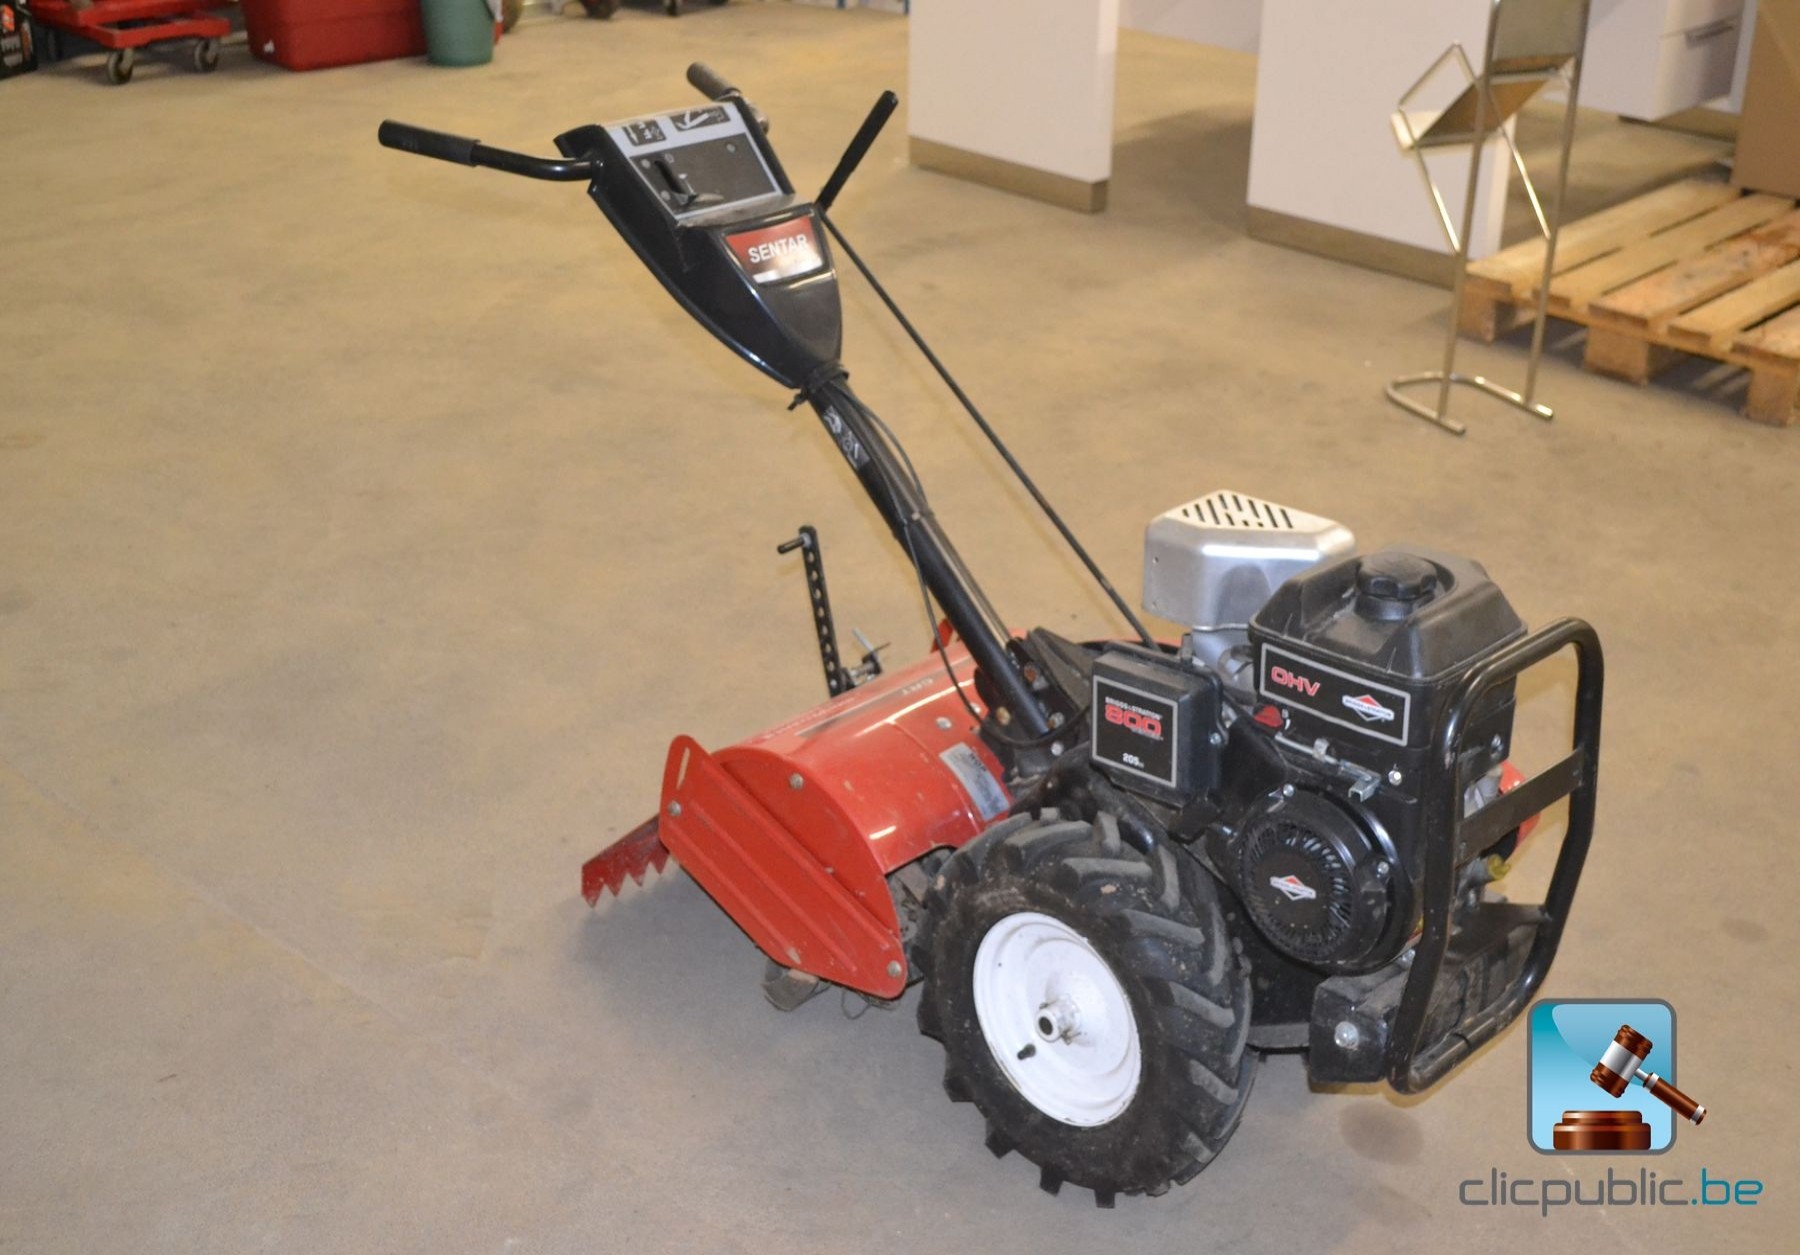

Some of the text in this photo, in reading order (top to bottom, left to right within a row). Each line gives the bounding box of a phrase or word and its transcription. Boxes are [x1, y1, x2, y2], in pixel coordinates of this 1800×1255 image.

[748, 234, 807, 264] SENTAR
[1271, 666, 1320, 696] OHV
[1105, 704, 1161, 736] 800
